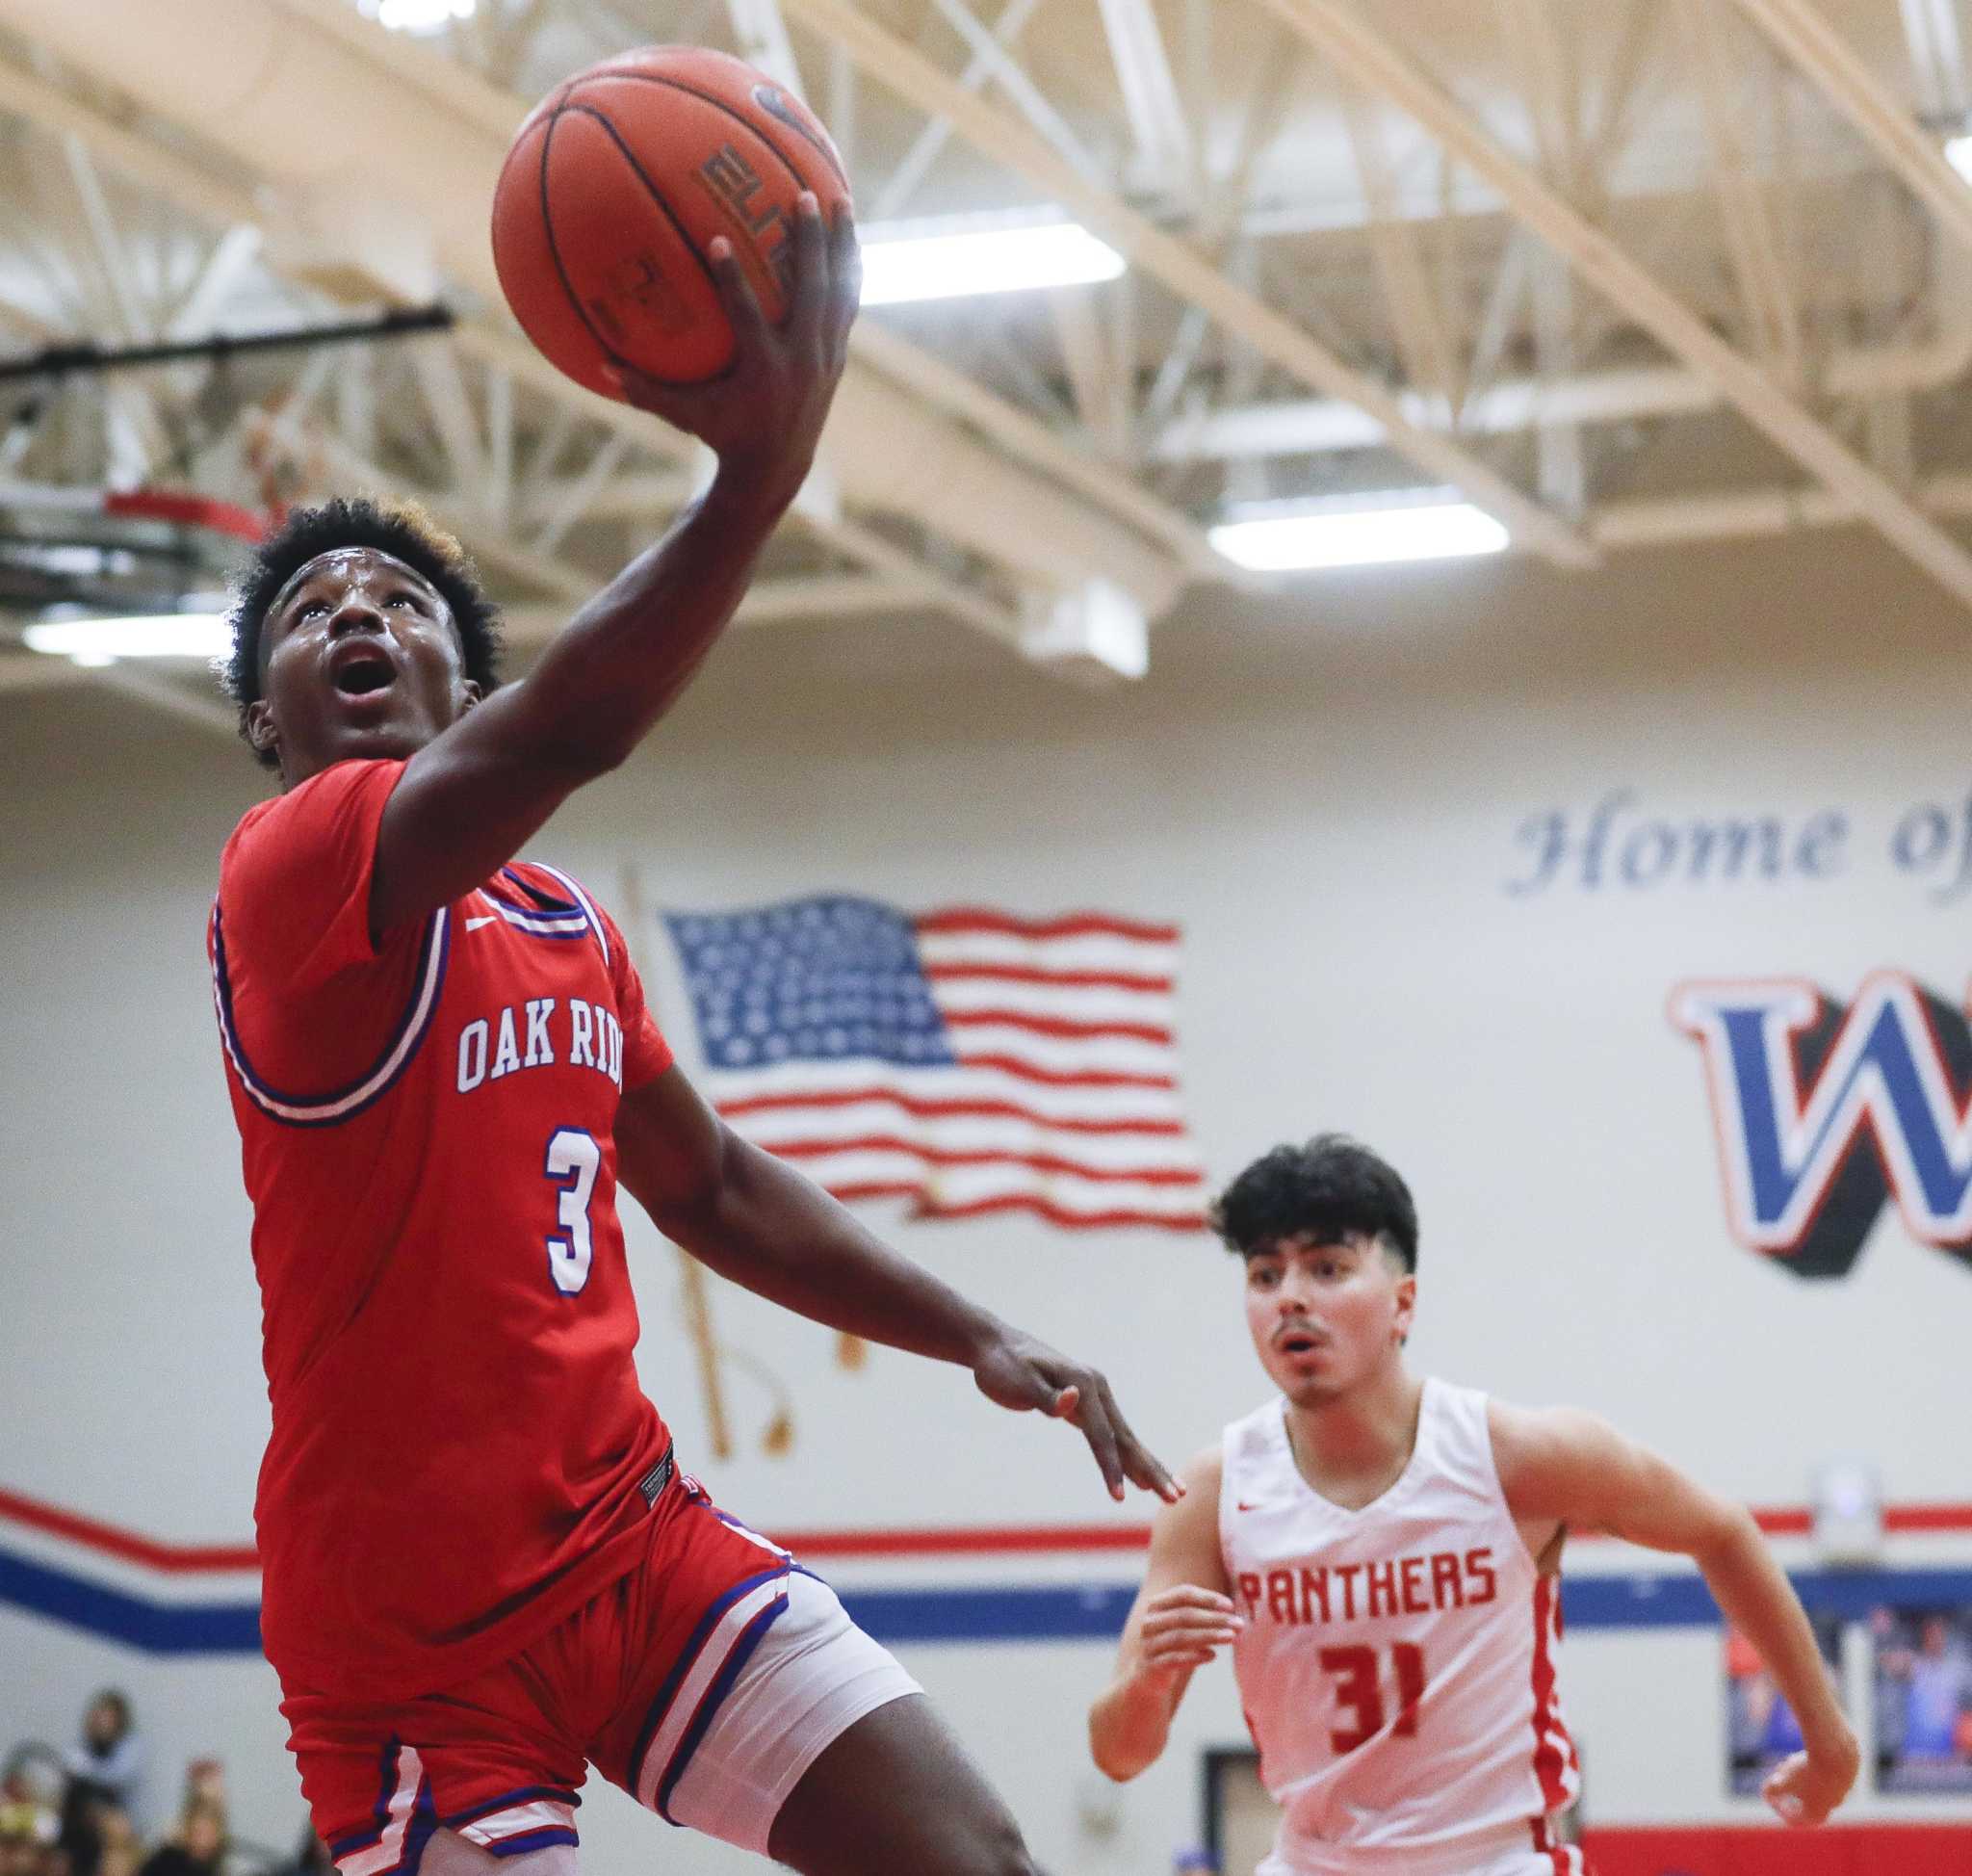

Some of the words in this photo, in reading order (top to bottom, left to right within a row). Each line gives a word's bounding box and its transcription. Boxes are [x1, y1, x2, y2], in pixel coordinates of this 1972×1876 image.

[1505, 788, 1851, 898] Home
[456, 998, 556, 1095] OAK
[569, 996, 624, 1095] RID
[544, 1125, 601, 1297] 3
[1237, 1547, 1496, 1626] PANTHERS
[1316, 1639, 1425, 1756] 31
